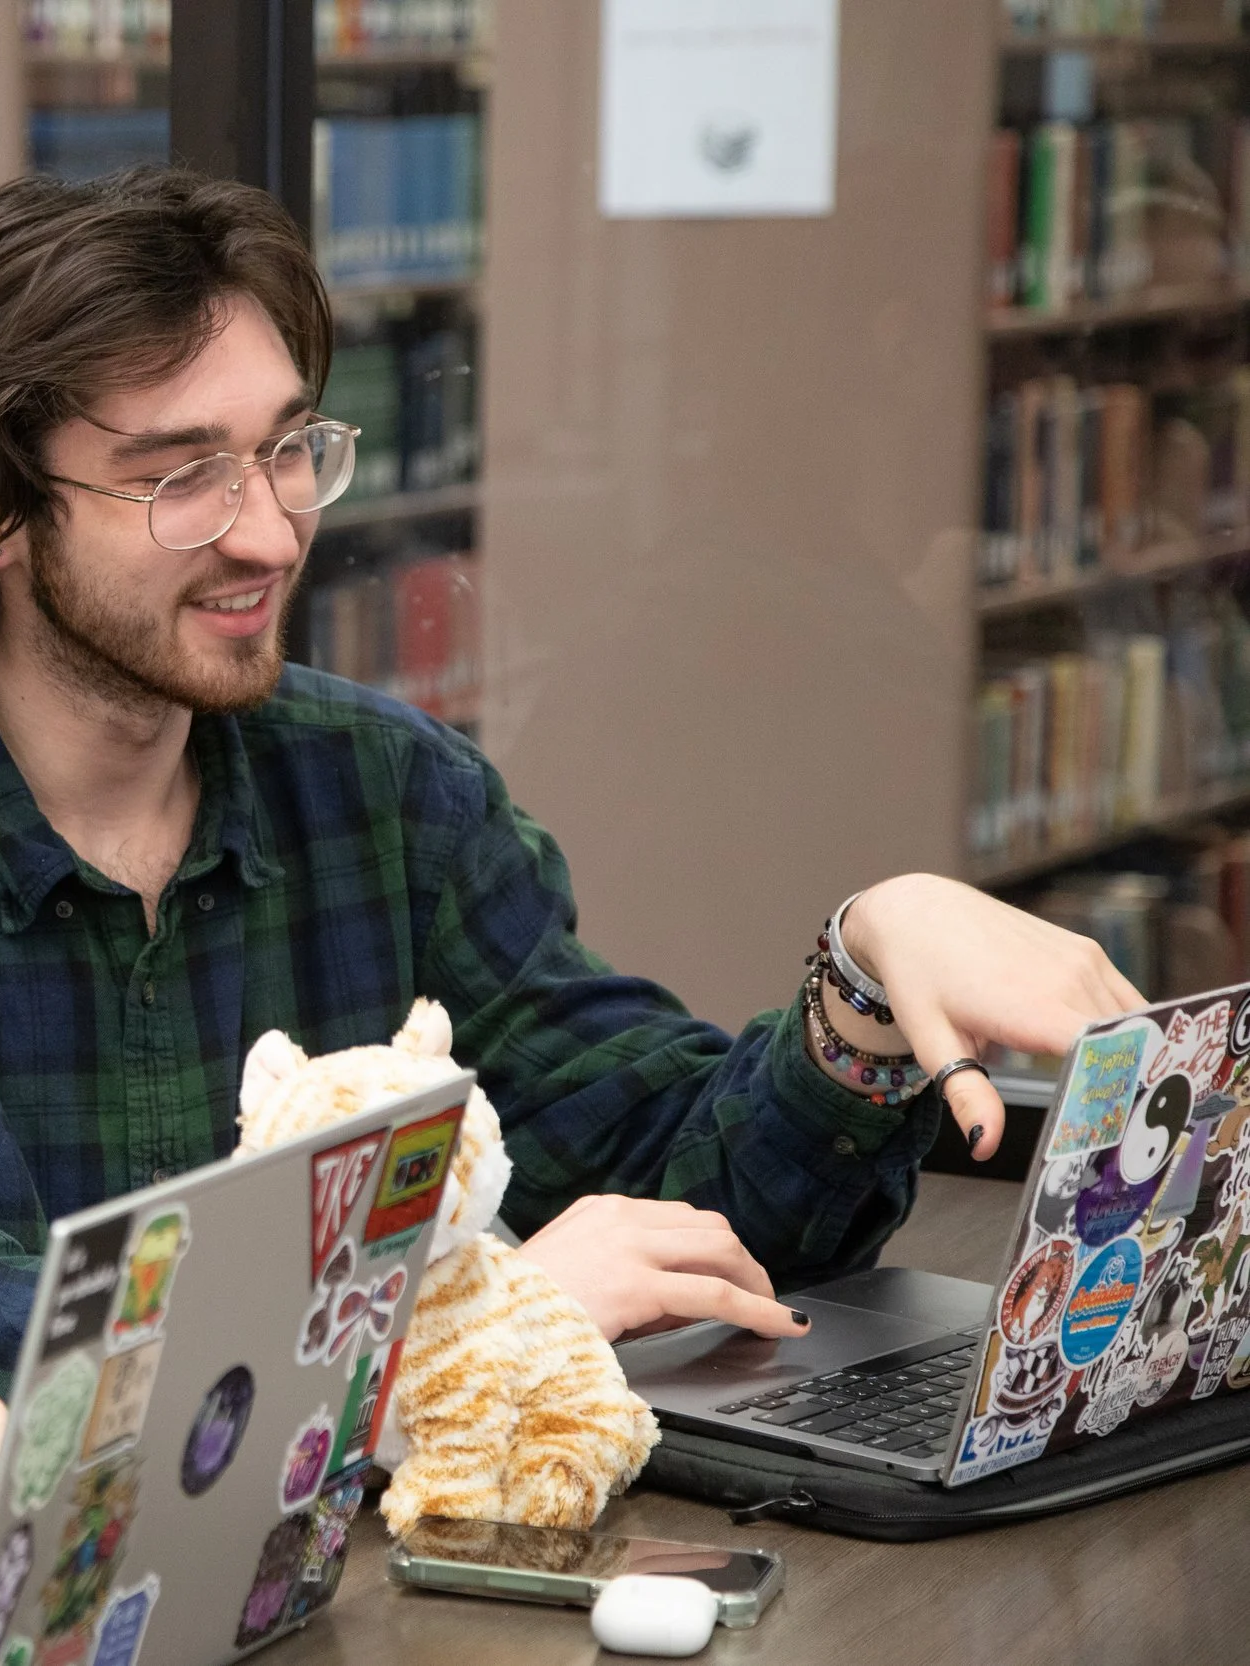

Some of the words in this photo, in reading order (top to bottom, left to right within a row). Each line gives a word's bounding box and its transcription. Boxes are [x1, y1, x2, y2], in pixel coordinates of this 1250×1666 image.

[1168, 1015, 1190, 1044] BE
[1196, 1006, 1228, 1041] THE
[1216, 1317, 1249, 1342] THINGS
[1148, 1352, 1183, 1374] FRENCH
[1203, 1353, 1233, 1376] WORK
[952, 1463, 980, 1482] UNITED
[979, 1453, 1018, 1475] METHODIST
[1016, 1443, 1045, 1464] CHURCH
